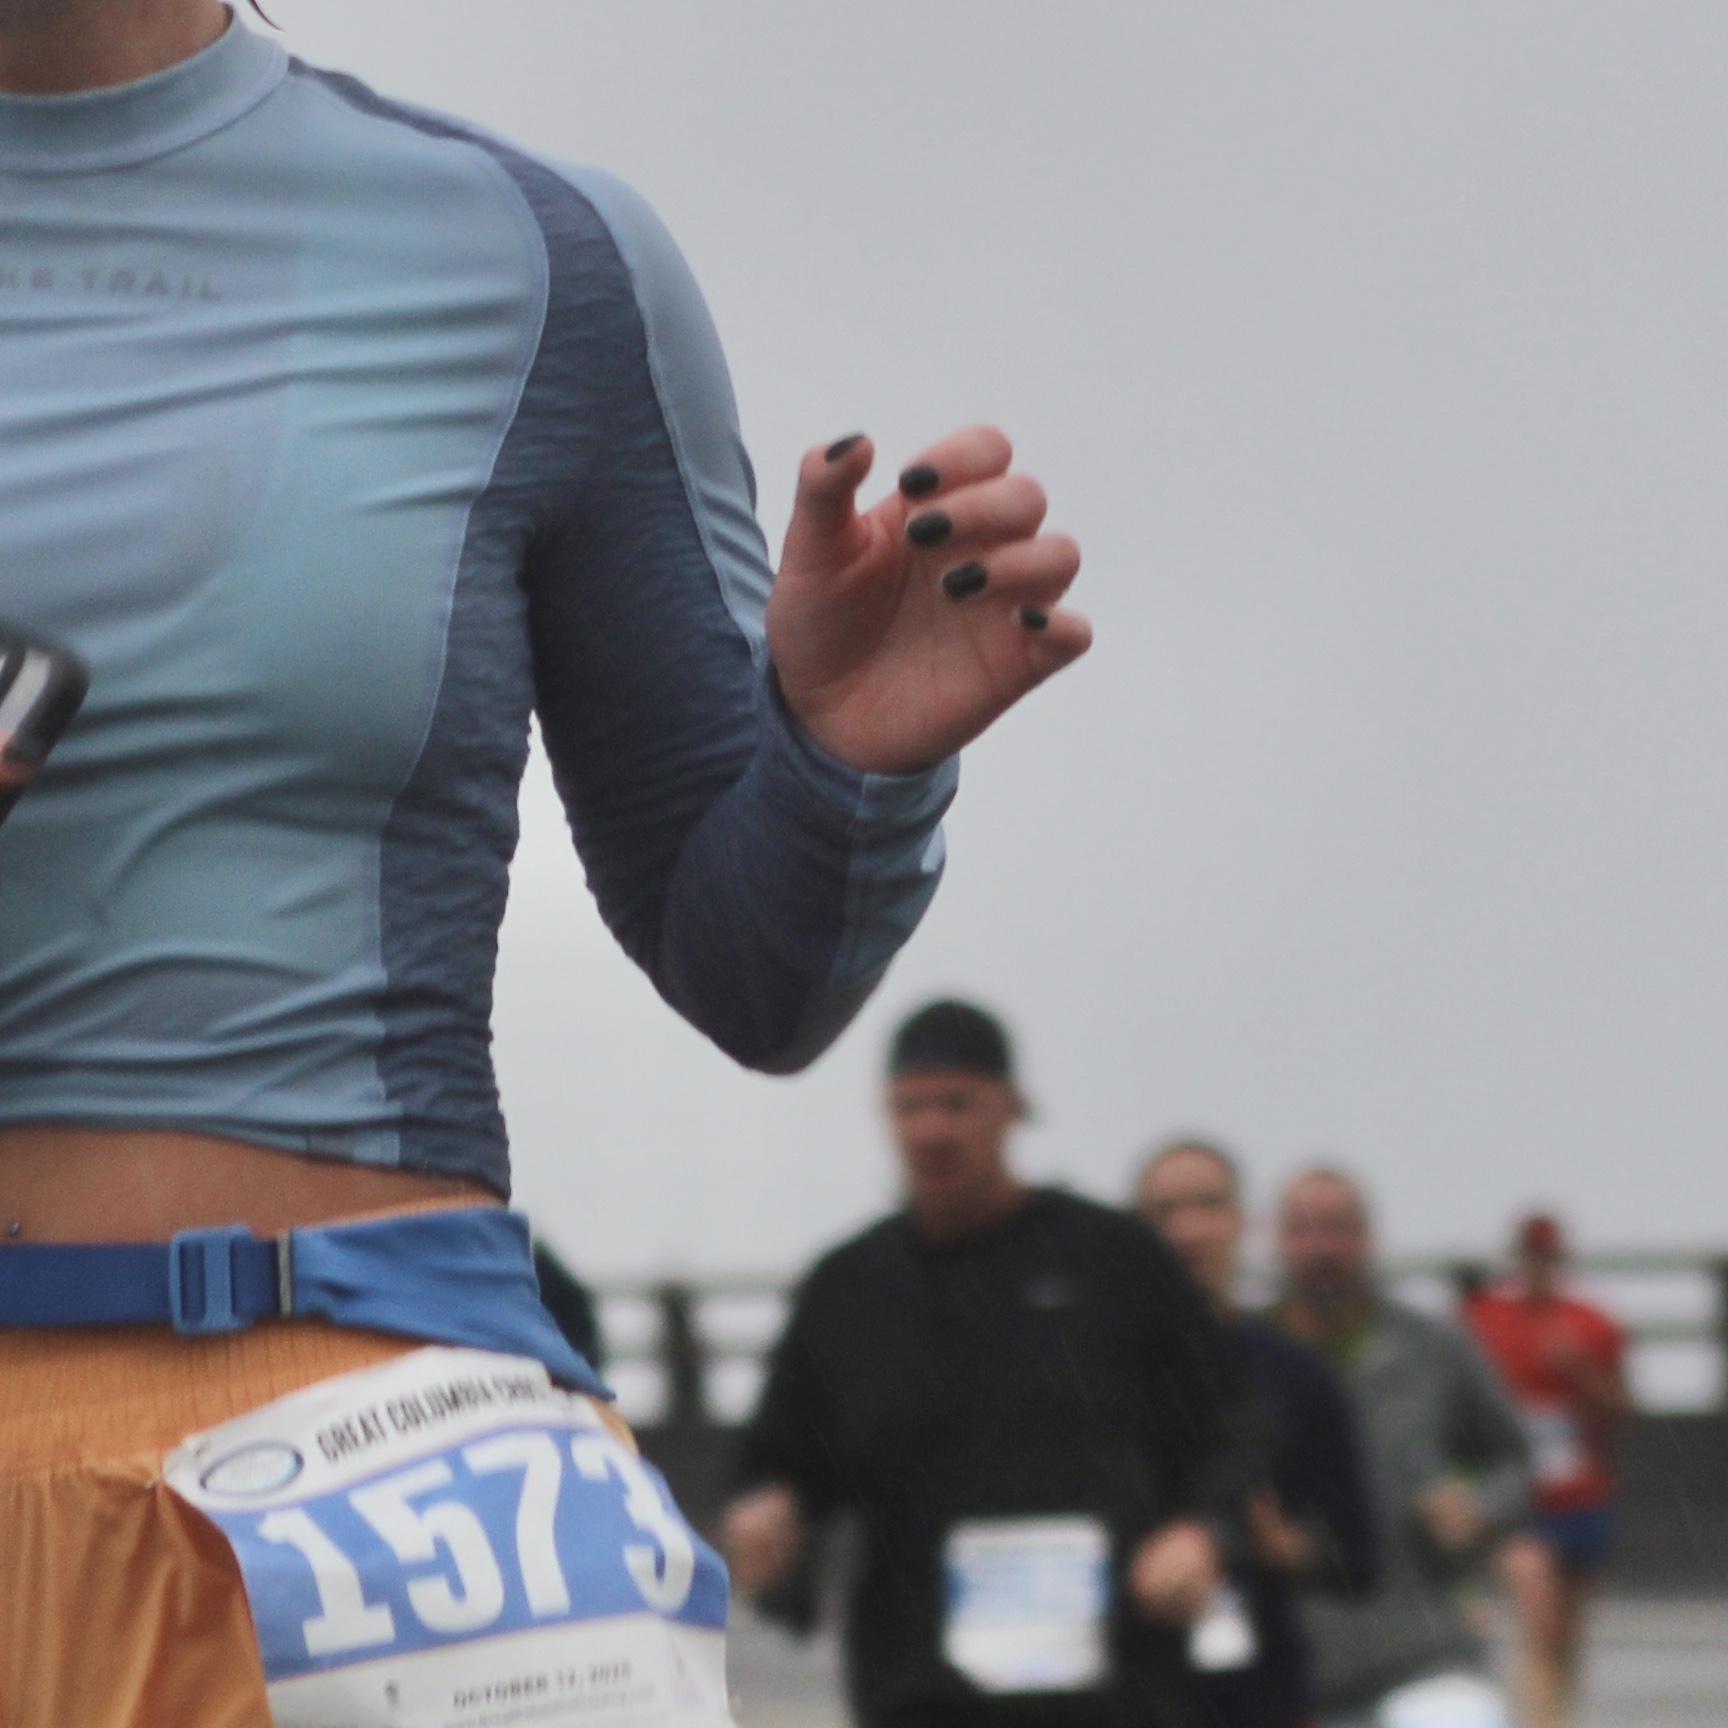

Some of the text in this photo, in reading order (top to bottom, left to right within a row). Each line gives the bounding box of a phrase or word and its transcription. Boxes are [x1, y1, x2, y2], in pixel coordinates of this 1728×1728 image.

[78, 268, 221, 302] TRAIL
[316, 1404, 387, 1463] GREAT
[384, 1375, 492, 1435] COLUMBIA
[255, 1428, 696, 1658] 1573
[452, 1672, 549, 1712] OCTOBER
